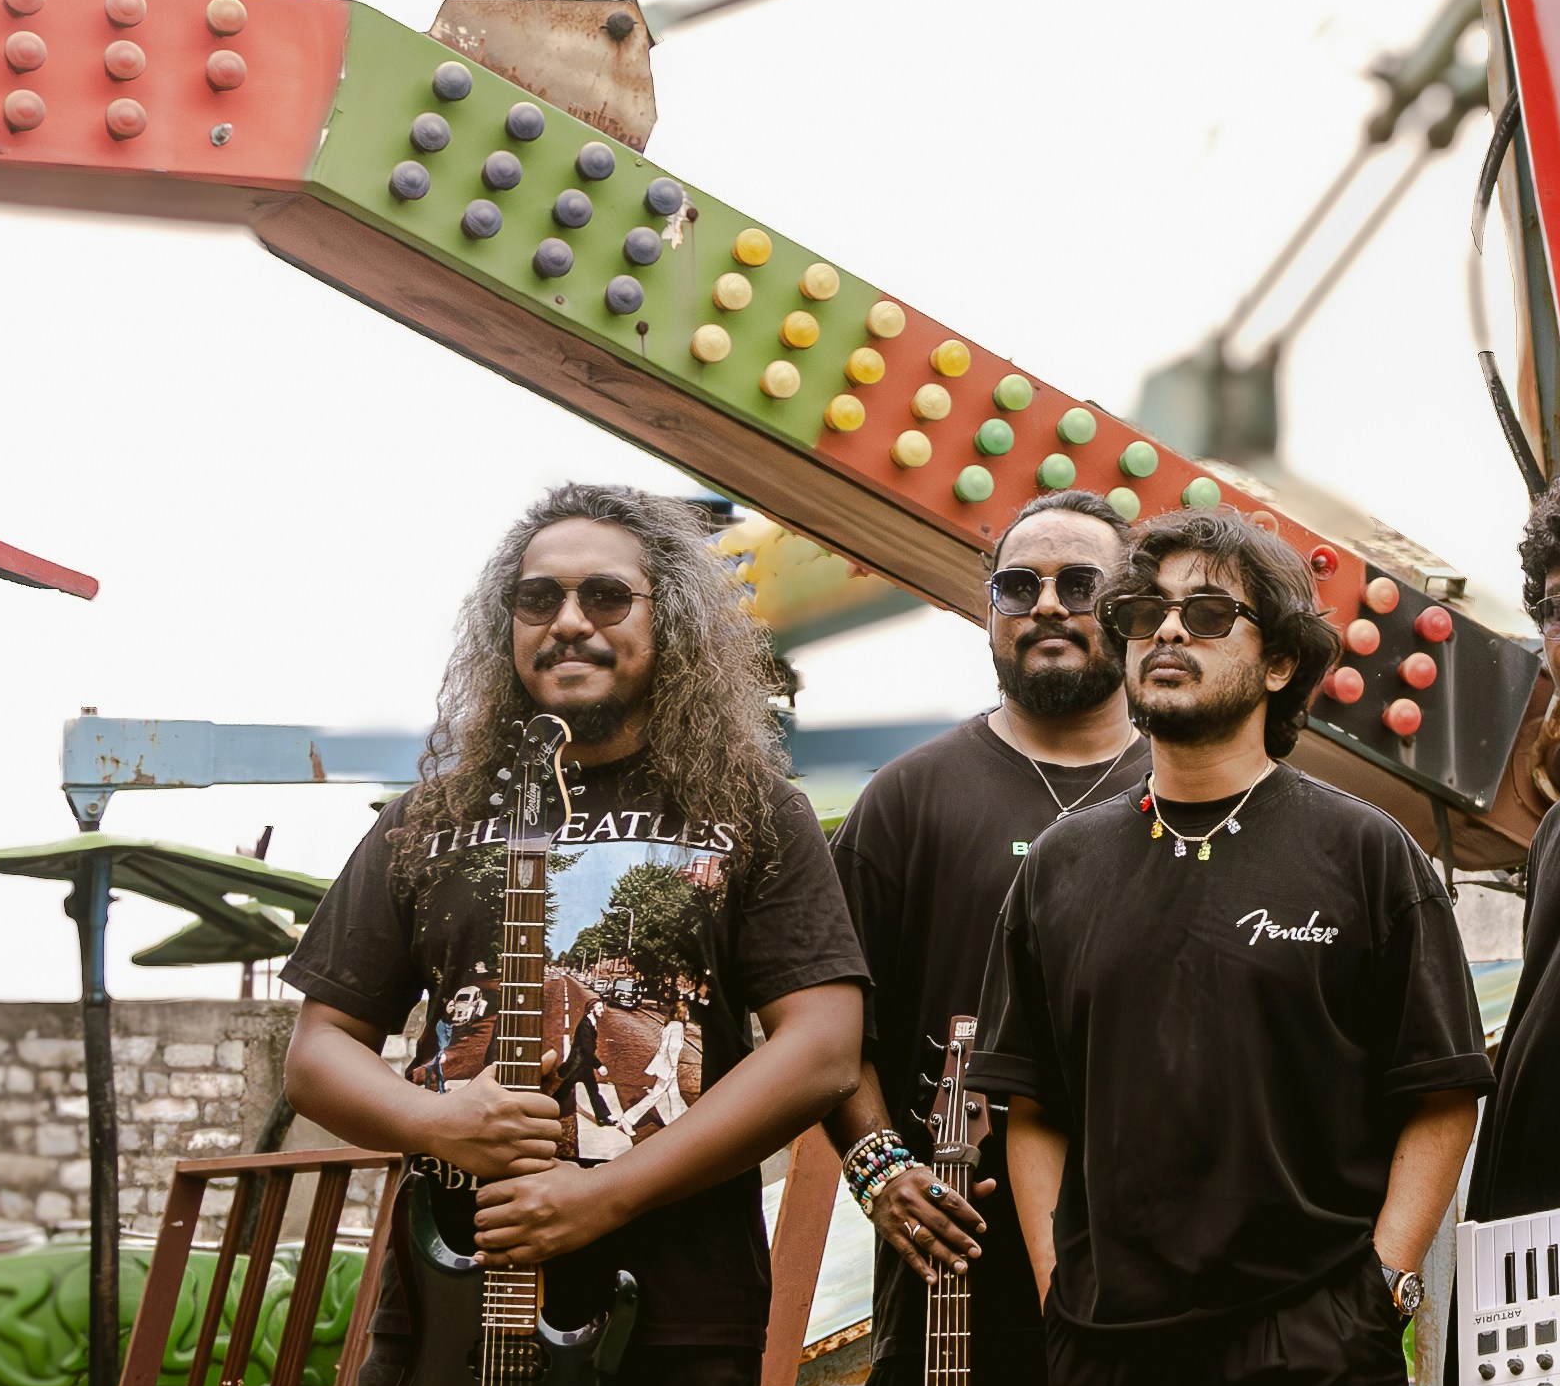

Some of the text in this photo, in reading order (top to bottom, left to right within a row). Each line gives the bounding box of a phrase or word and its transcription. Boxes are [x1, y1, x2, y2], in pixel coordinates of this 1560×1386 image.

[424, 810, 738, 859] THE EATLES
[1236, 908, 1334, 946] Fender
[1474, 1309, 1523, 1325] ARTURIA
